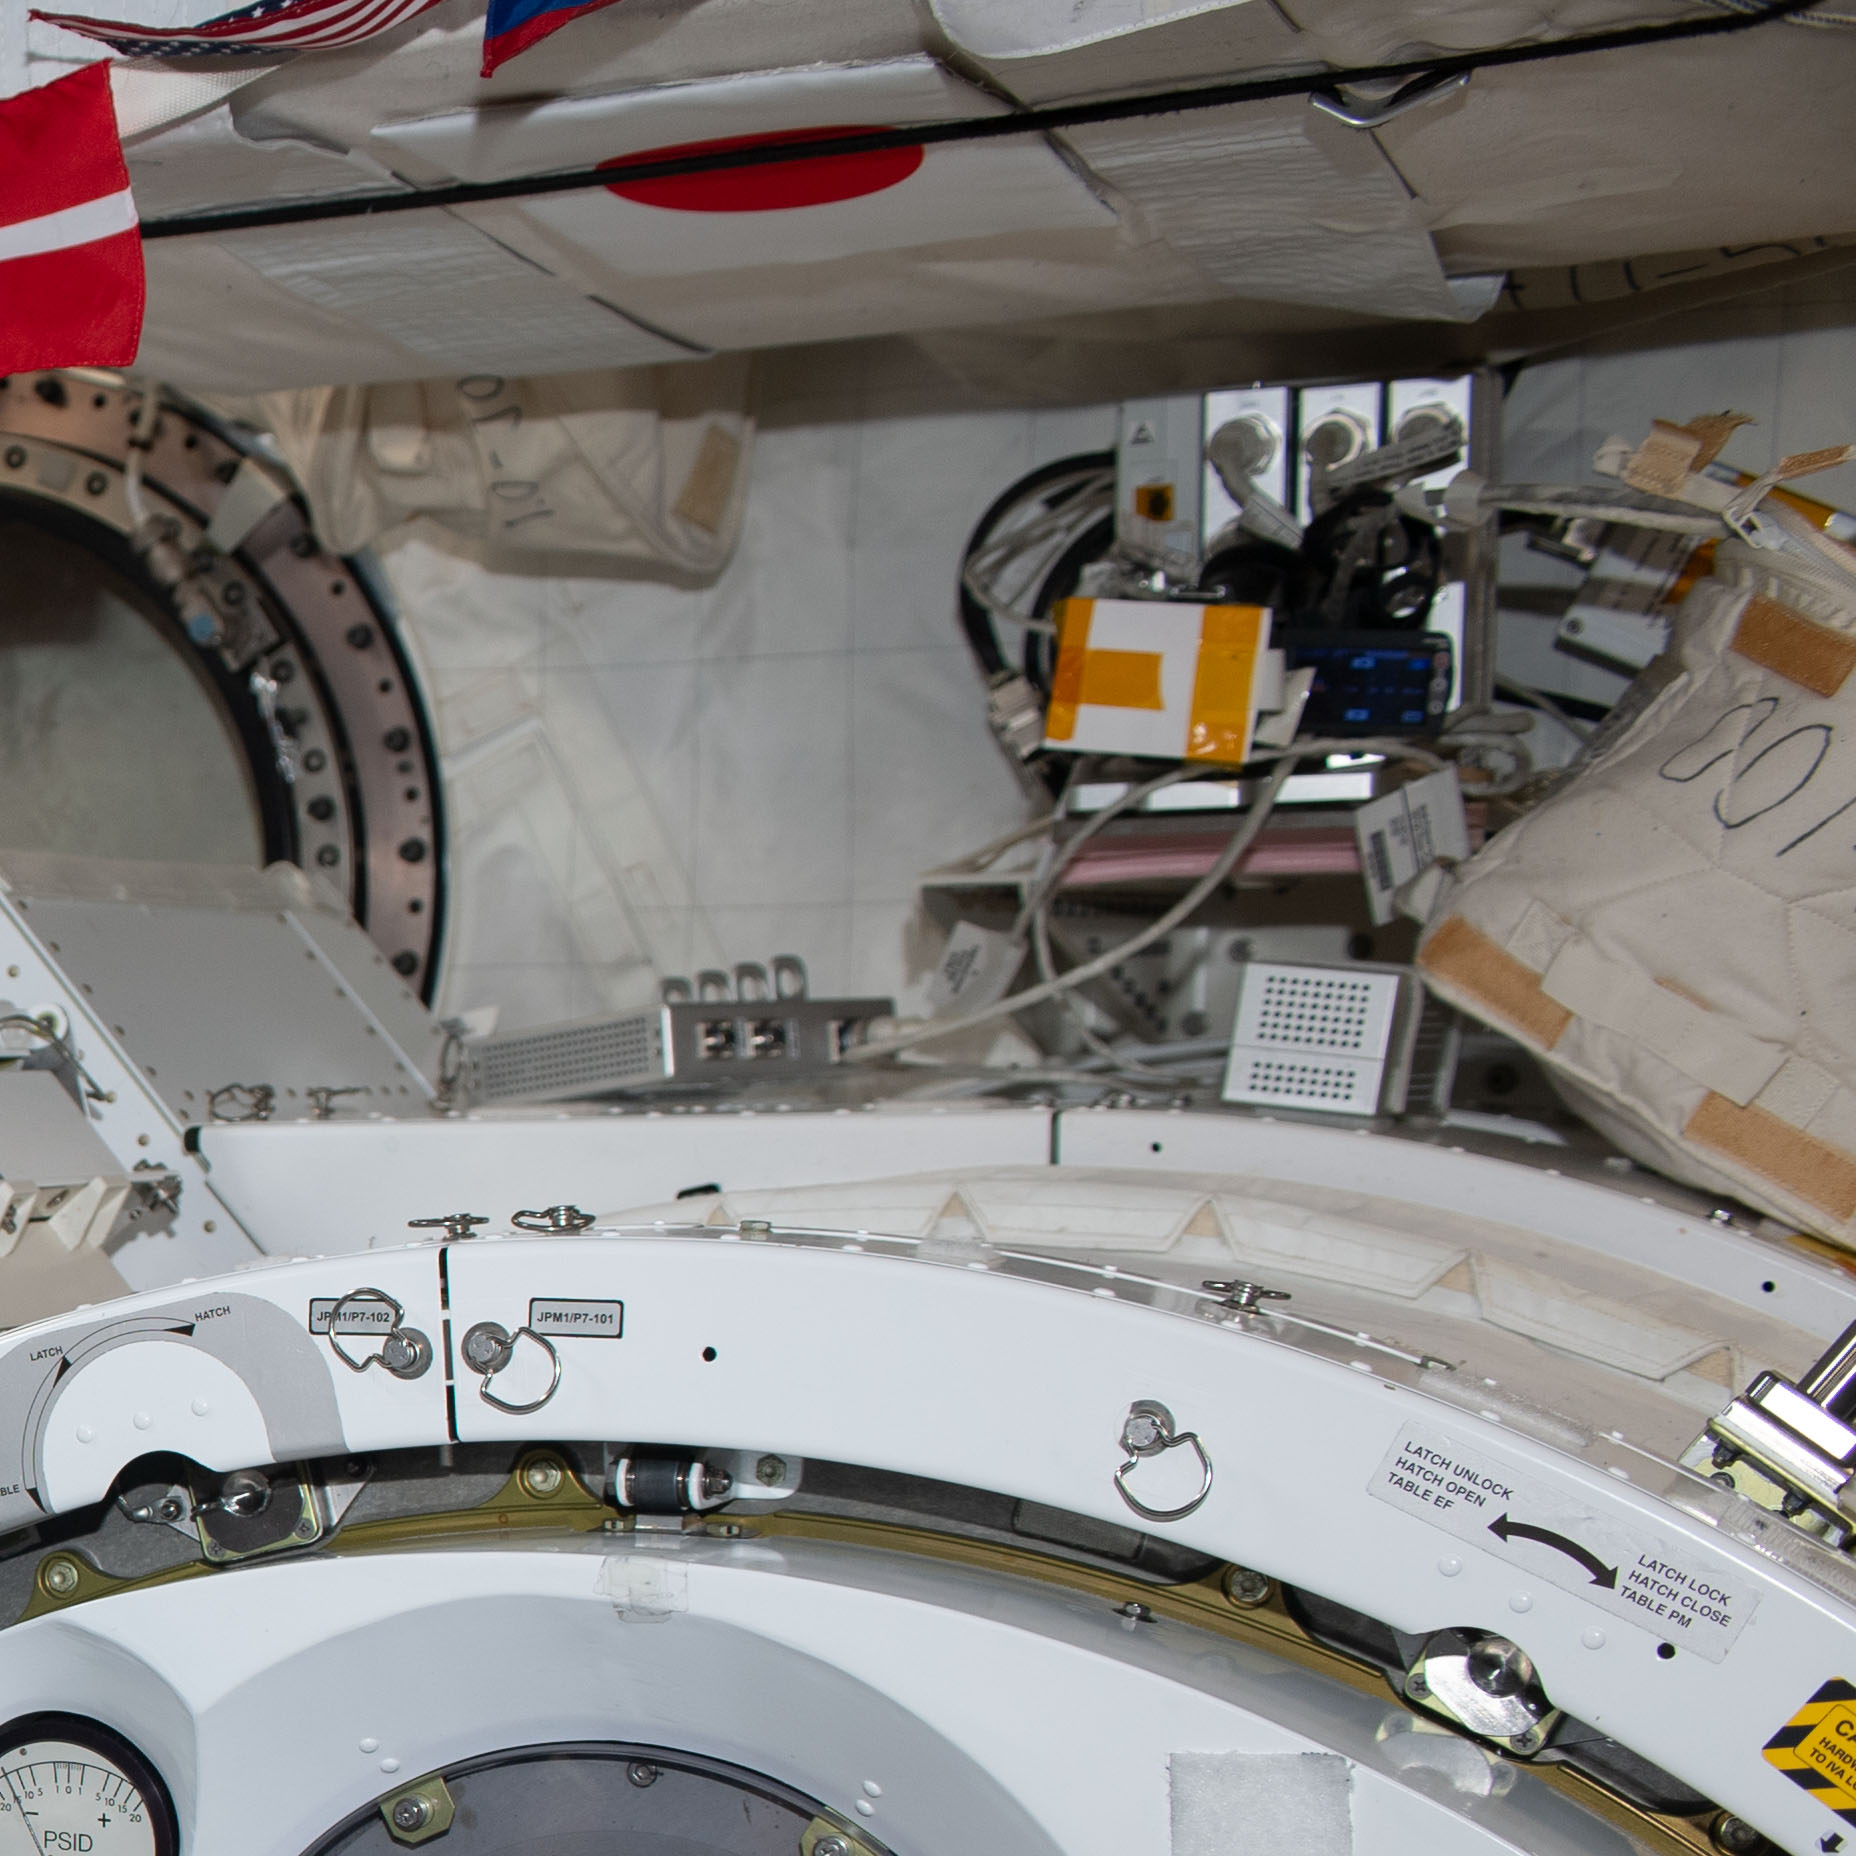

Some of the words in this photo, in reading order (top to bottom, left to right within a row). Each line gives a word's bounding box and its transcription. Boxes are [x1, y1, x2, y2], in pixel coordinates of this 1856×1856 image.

[194, 1305, 231, 1322] HATCH
[536, 1311, 614, 1324] JPM1/P7-101
[29, 1345, 64, 1361] LATCH
[1404, 1441, 1452, 1471] LATCH
[1453, 1464, 1515, 1501] UNLOCK
[1395, 1456, 1444, 1487] HATCH
[1446, 1481, 1487, 1507] OPEN
[1387, 1471, 1433, 1501] TABLE
[1433, 1495, 1455, 1510] EF
[1638, 1554, 1688, 1585] LATCH
[1688, 1578, 1731, 1606] LOCK
[1620, 1585, 1666, 1616] TABLE
[1667, 1610, 1692, 1628] PM
[1628, 1570, 1679, 1601] HATCH
[1680, 1596, 1732, 1628] CLOSE
[1808, 1748, 1826, 1765] TO
[1825, 1761, 1846, 1780] IVA
[24, 1791, 34, 1800] 10
[38, 1788, 43, 1797] 5
[65, 1786, 72, 1794] 0
[95, 1793, 101, 1801] 5
[0, 1802, 12, 1812] 20
[104, 1797, 115, 1807] 10
[118, 1804, 127, 1813] 15
[129, 1813, 142, 1823] 20
[43, 1830, 93, 1852] PSID
